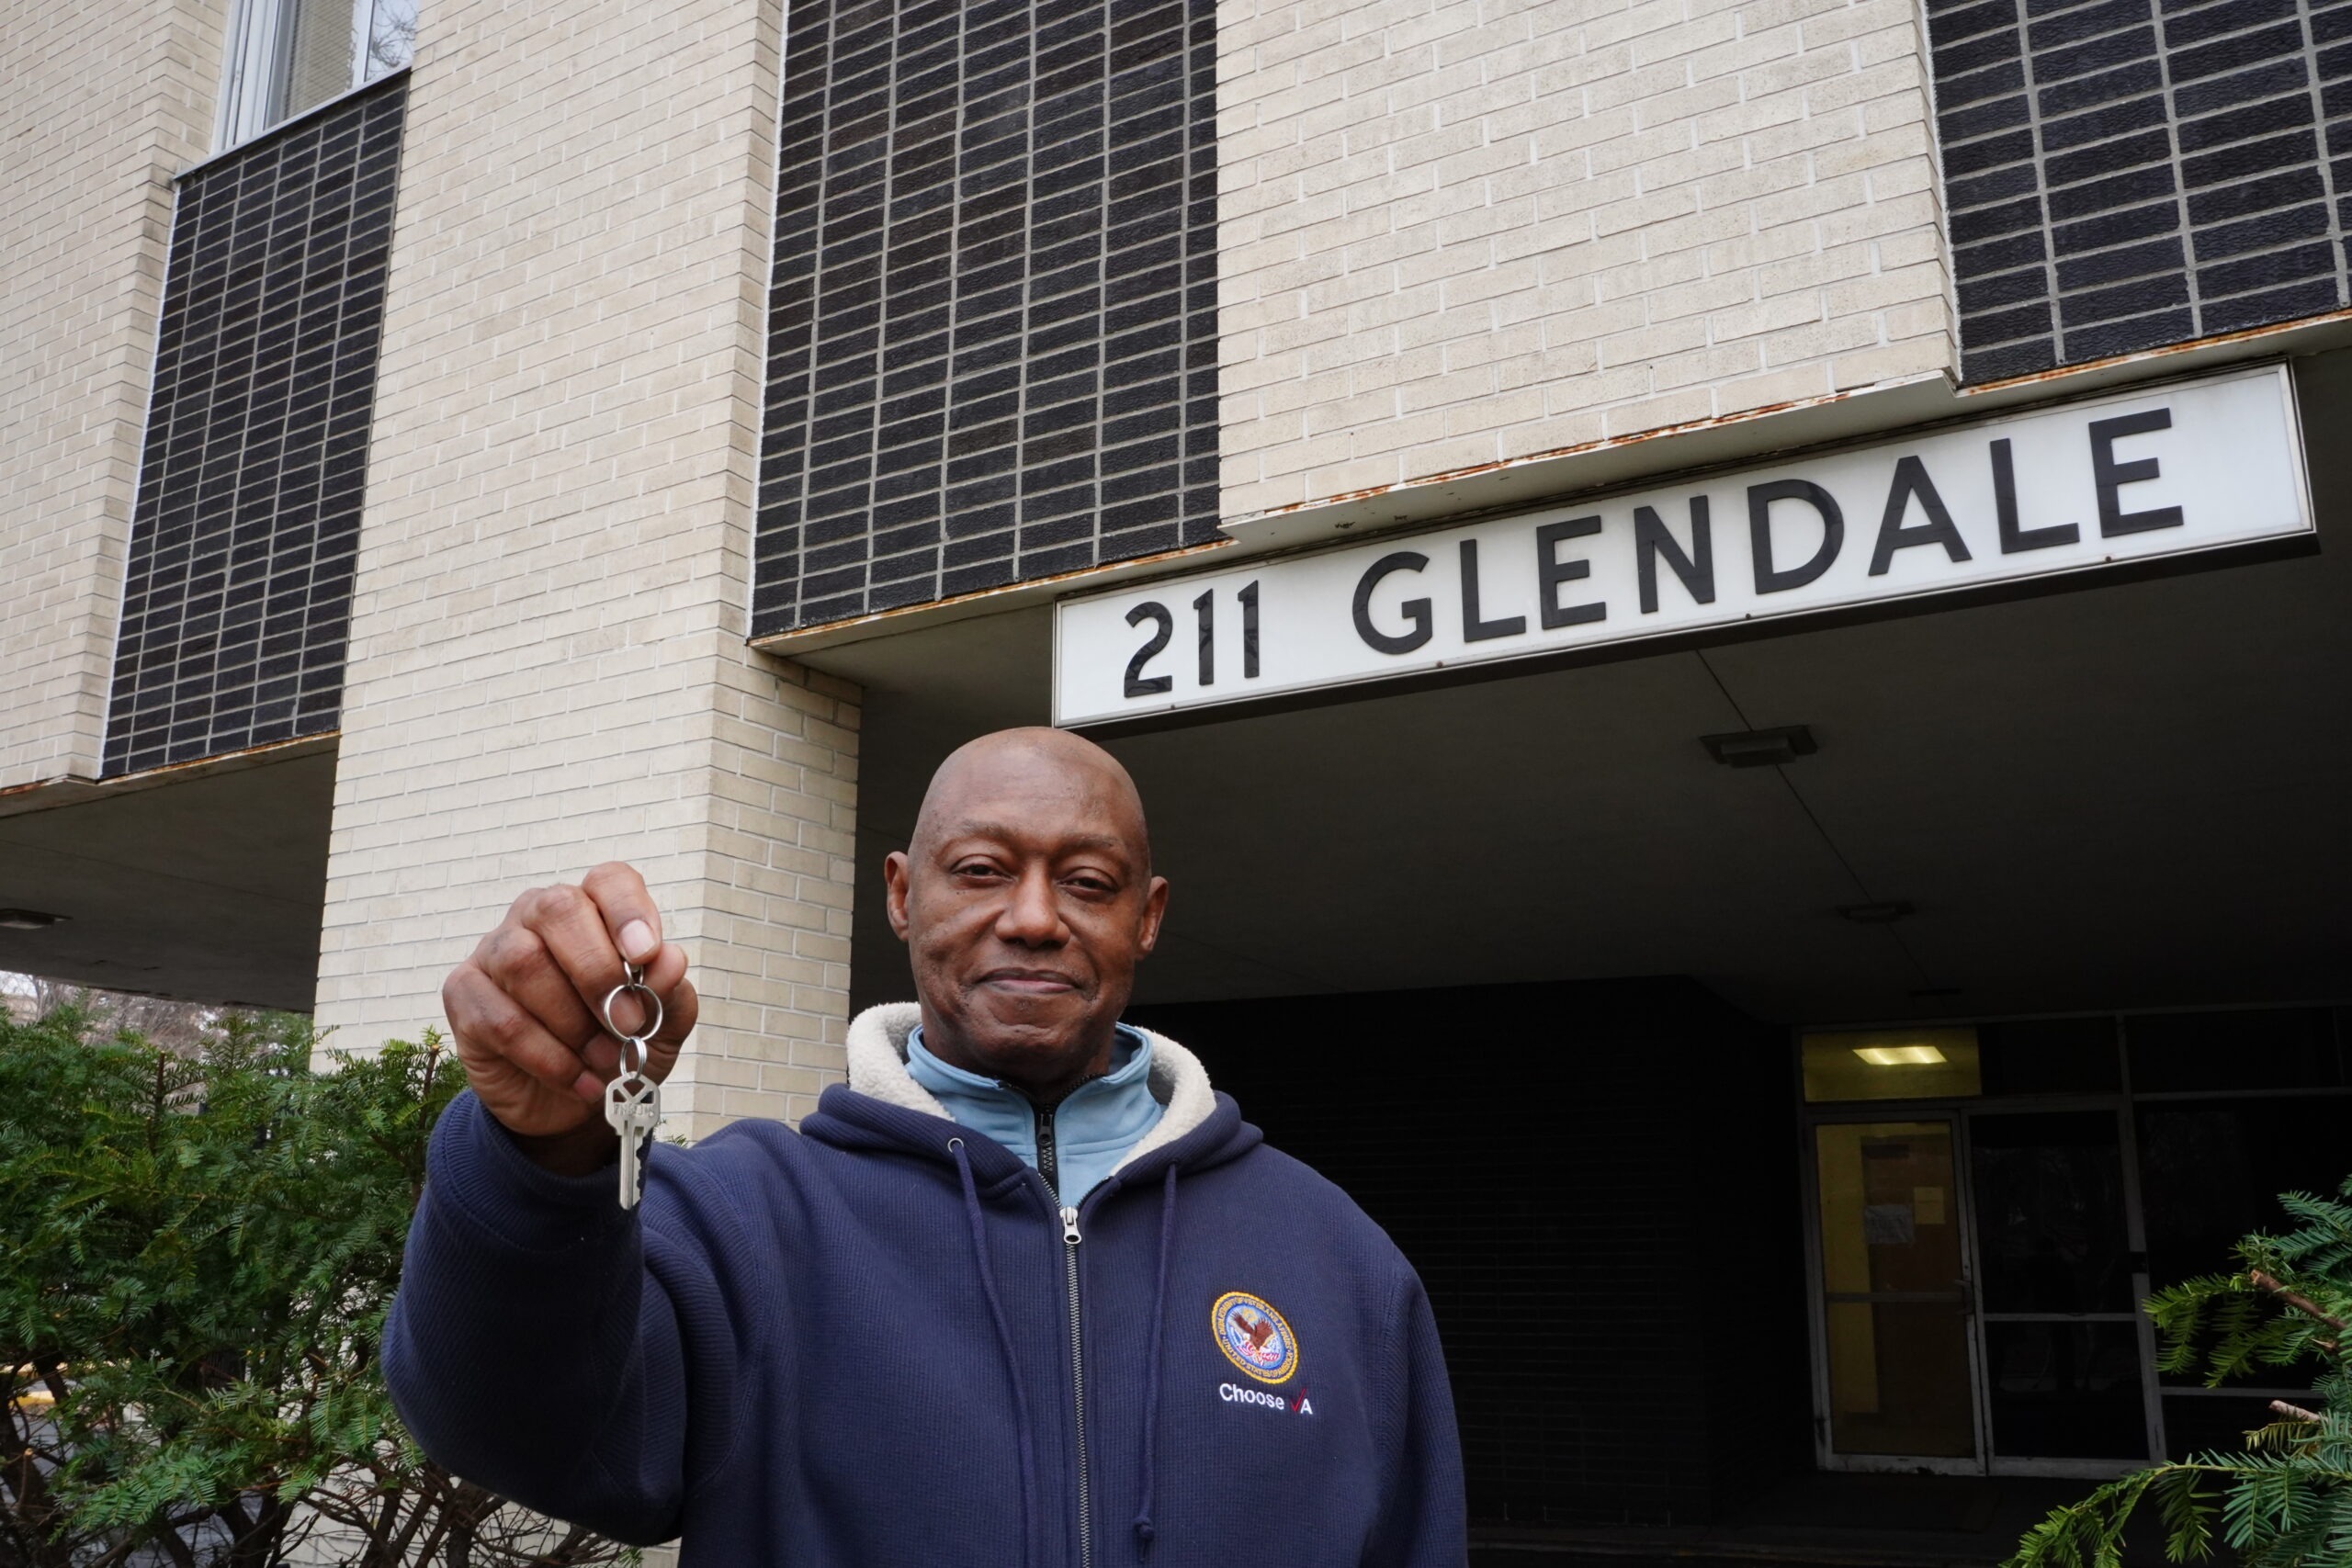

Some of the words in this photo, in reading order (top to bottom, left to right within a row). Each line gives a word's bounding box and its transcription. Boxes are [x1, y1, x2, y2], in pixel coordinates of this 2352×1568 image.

[1125, 581, 1261, 700] 211
[1351, 406, 2185, 657] GLENDALE
[1219, 1382, 1285, 1410] Choose
